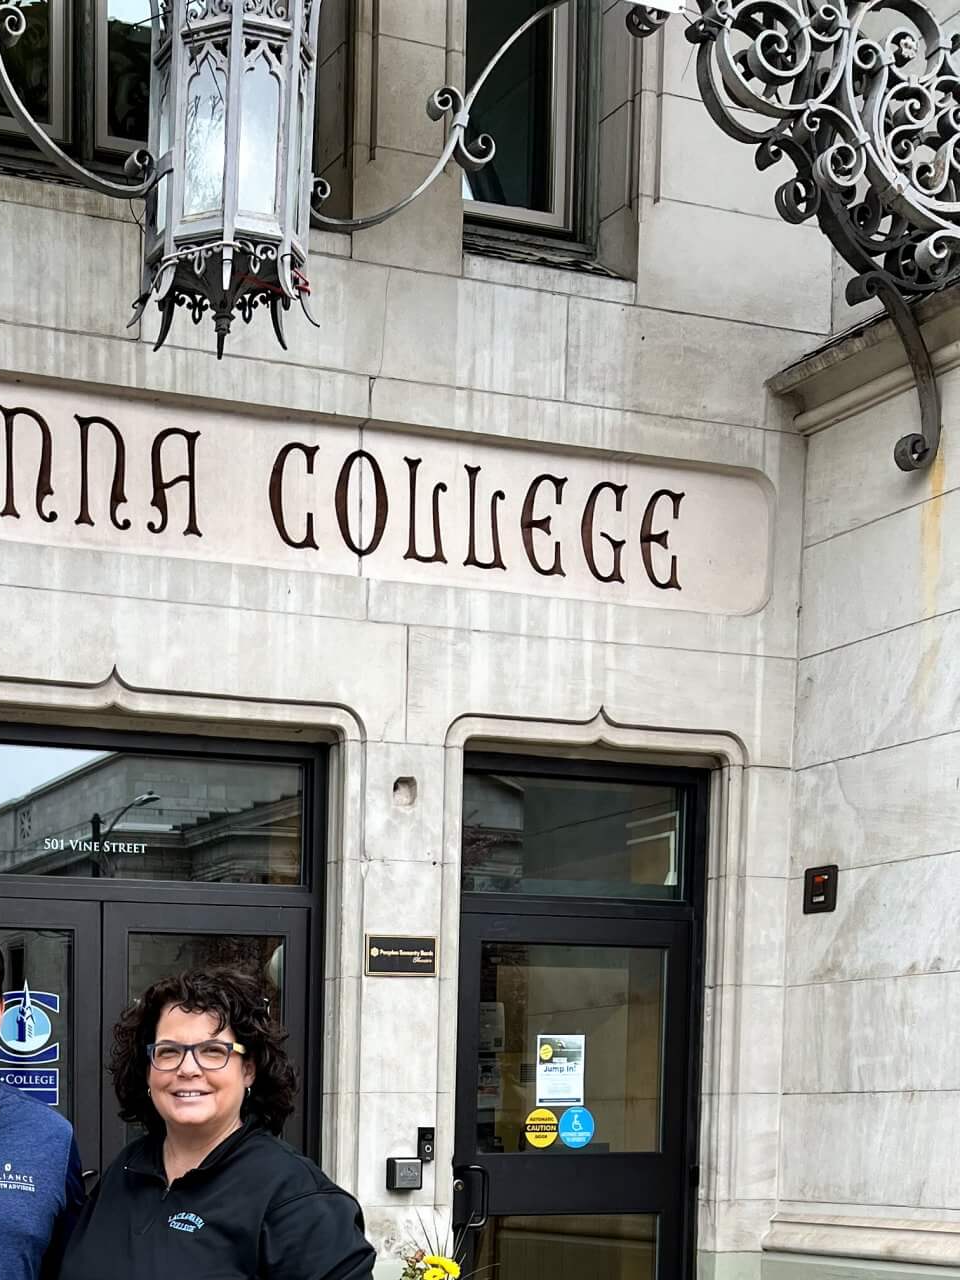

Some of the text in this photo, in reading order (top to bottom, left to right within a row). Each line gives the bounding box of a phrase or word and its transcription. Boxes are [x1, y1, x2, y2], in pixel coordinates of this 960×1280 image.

[268, 441, 687, 593] COLLEGE
[43, 838, 148, 854] 501 VINE STREET
[5, 1073, 56, 1085] COLLEGE
[526, 1124, 557, 1132] CAUTION
[8, 1183, 36, 1193] ADVISORS
